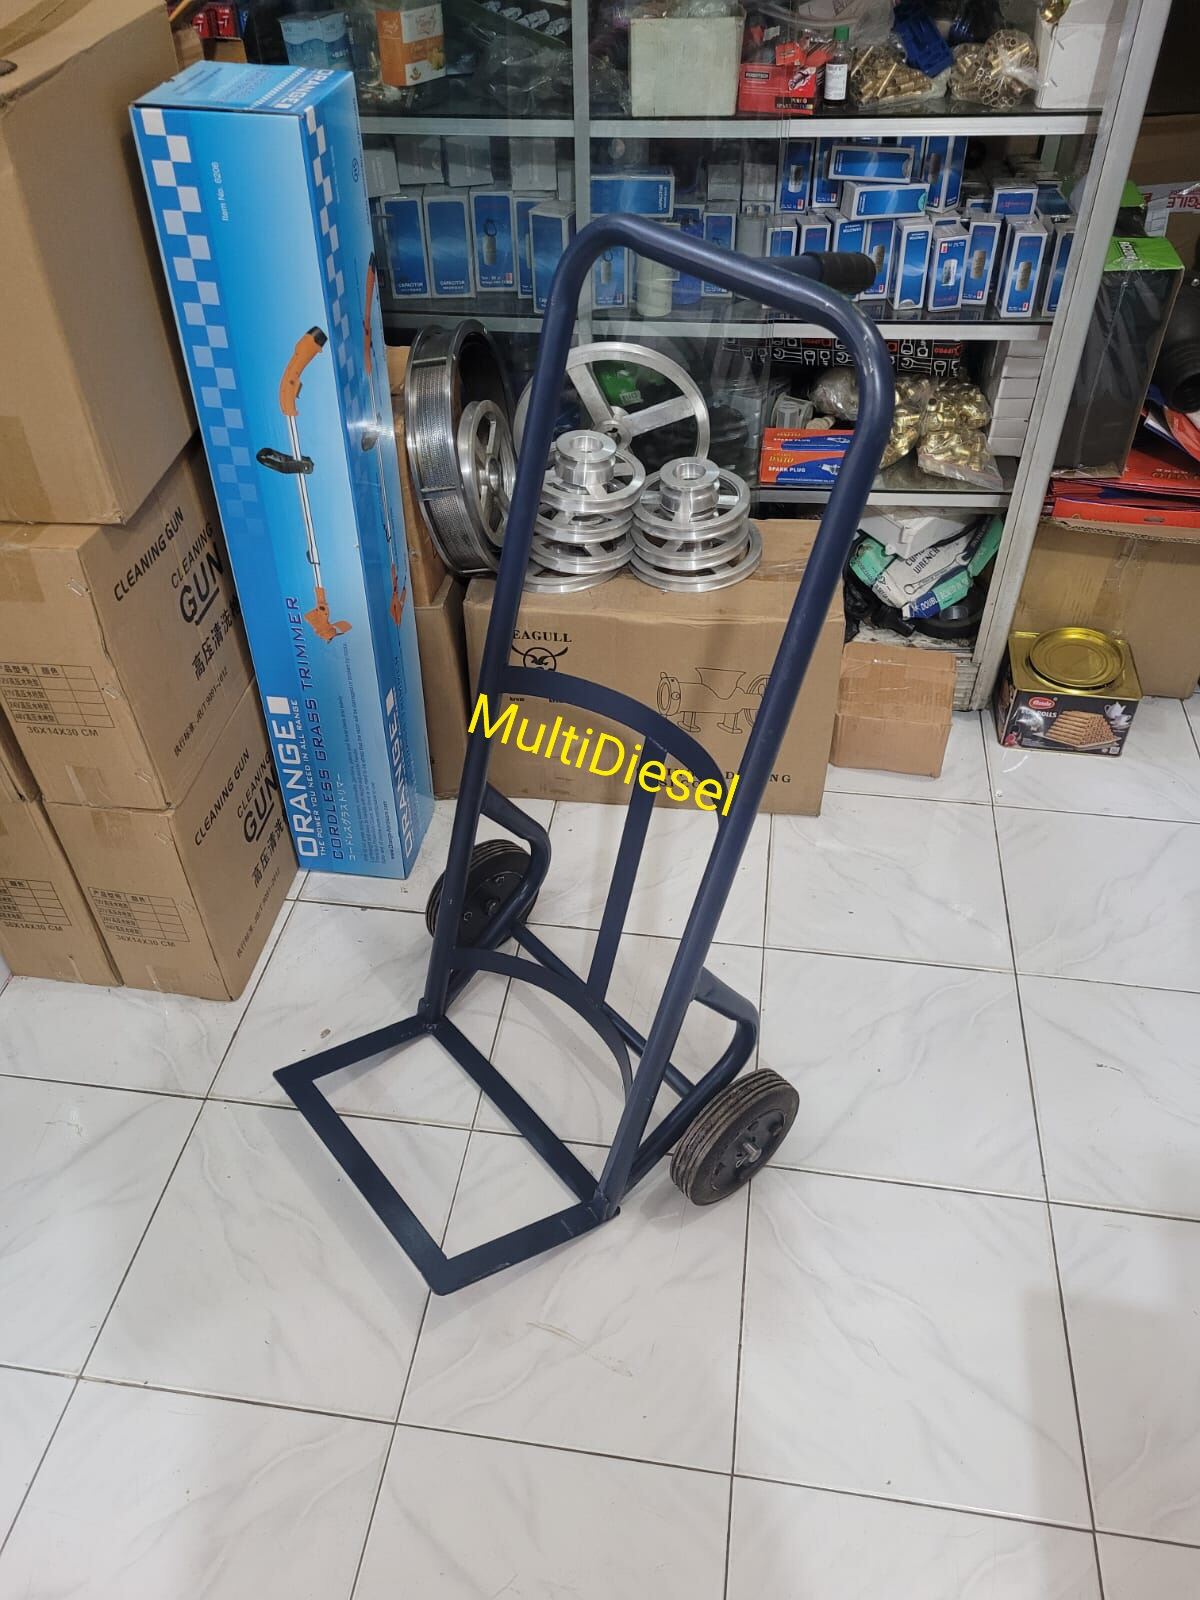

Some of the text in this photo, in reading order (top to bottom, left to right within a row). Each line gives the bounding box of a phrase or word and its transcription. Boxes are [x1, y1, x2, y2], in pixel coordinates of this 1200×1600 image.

[281, 69, 335, 104] ORANGE
[221, 202, 229, 221] Item
[114, 506, 184, 601] CLEANING GUN
[171, 522, 213, 589] CLEANING
[180, 542, 224, 623] GUN
[512, 629, 572, 643] EAGULL
[81, 728, 99, 736] CM
[286, 597, 344, 860] CORDLESS GRASS TRIMMER
[194, 748, 250, 846] CLEANING GUN
[237, 751, 271, 819] CLEANING
[244, 765, 278, 843] GUN
[272, 719, 319, 857] ORANGE
[291, 699, 327, 856] THE POWER YOU NEED IN ALL RANGE
[389, 712, 414, 858] ORANGE
[251, 815, 286, 888] 高压清洗
